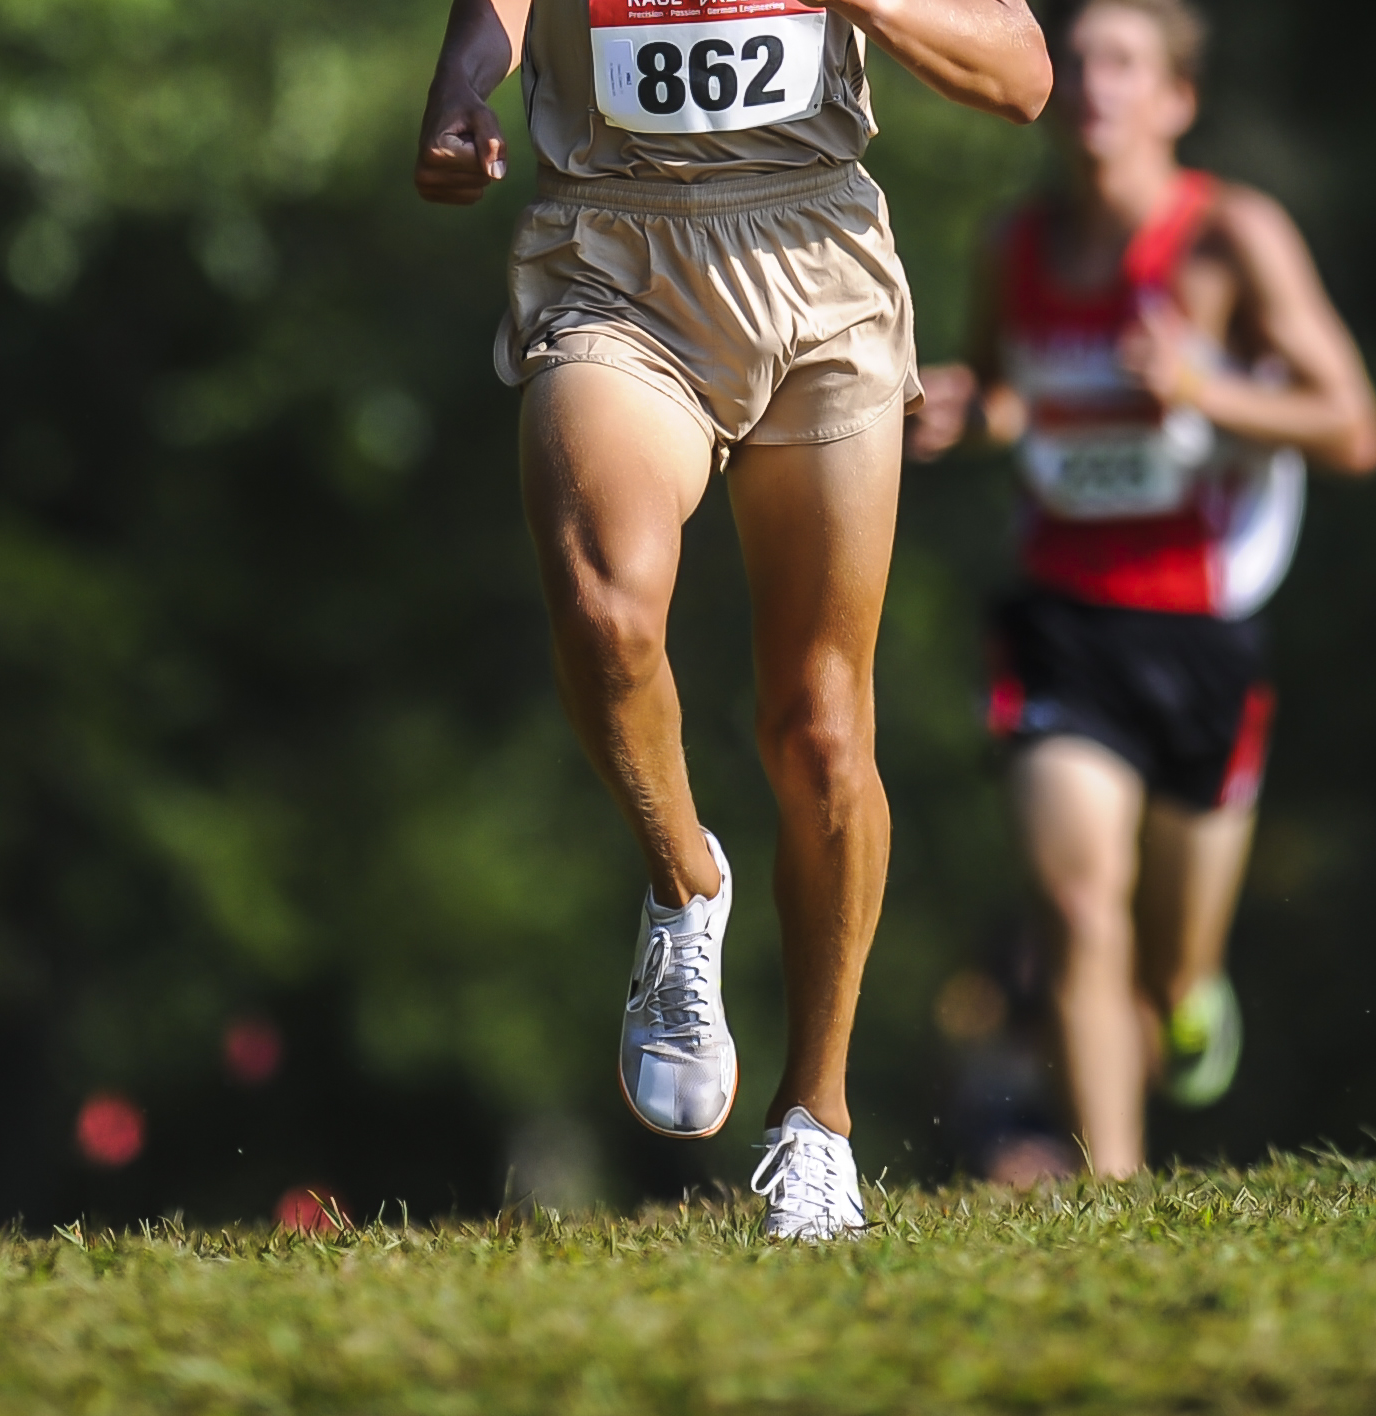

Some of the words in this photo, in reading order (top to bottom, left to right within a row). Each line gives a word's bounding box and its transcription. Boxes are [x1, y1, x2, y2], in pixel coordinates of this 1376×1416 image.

[628, 10, 665, 19] Precision
[670, 8, 701, 17] Passion
[707, 5, 738, 15] German
[739, 1, 785, 14] Engineering
[636, 35, 786, 115] 862
